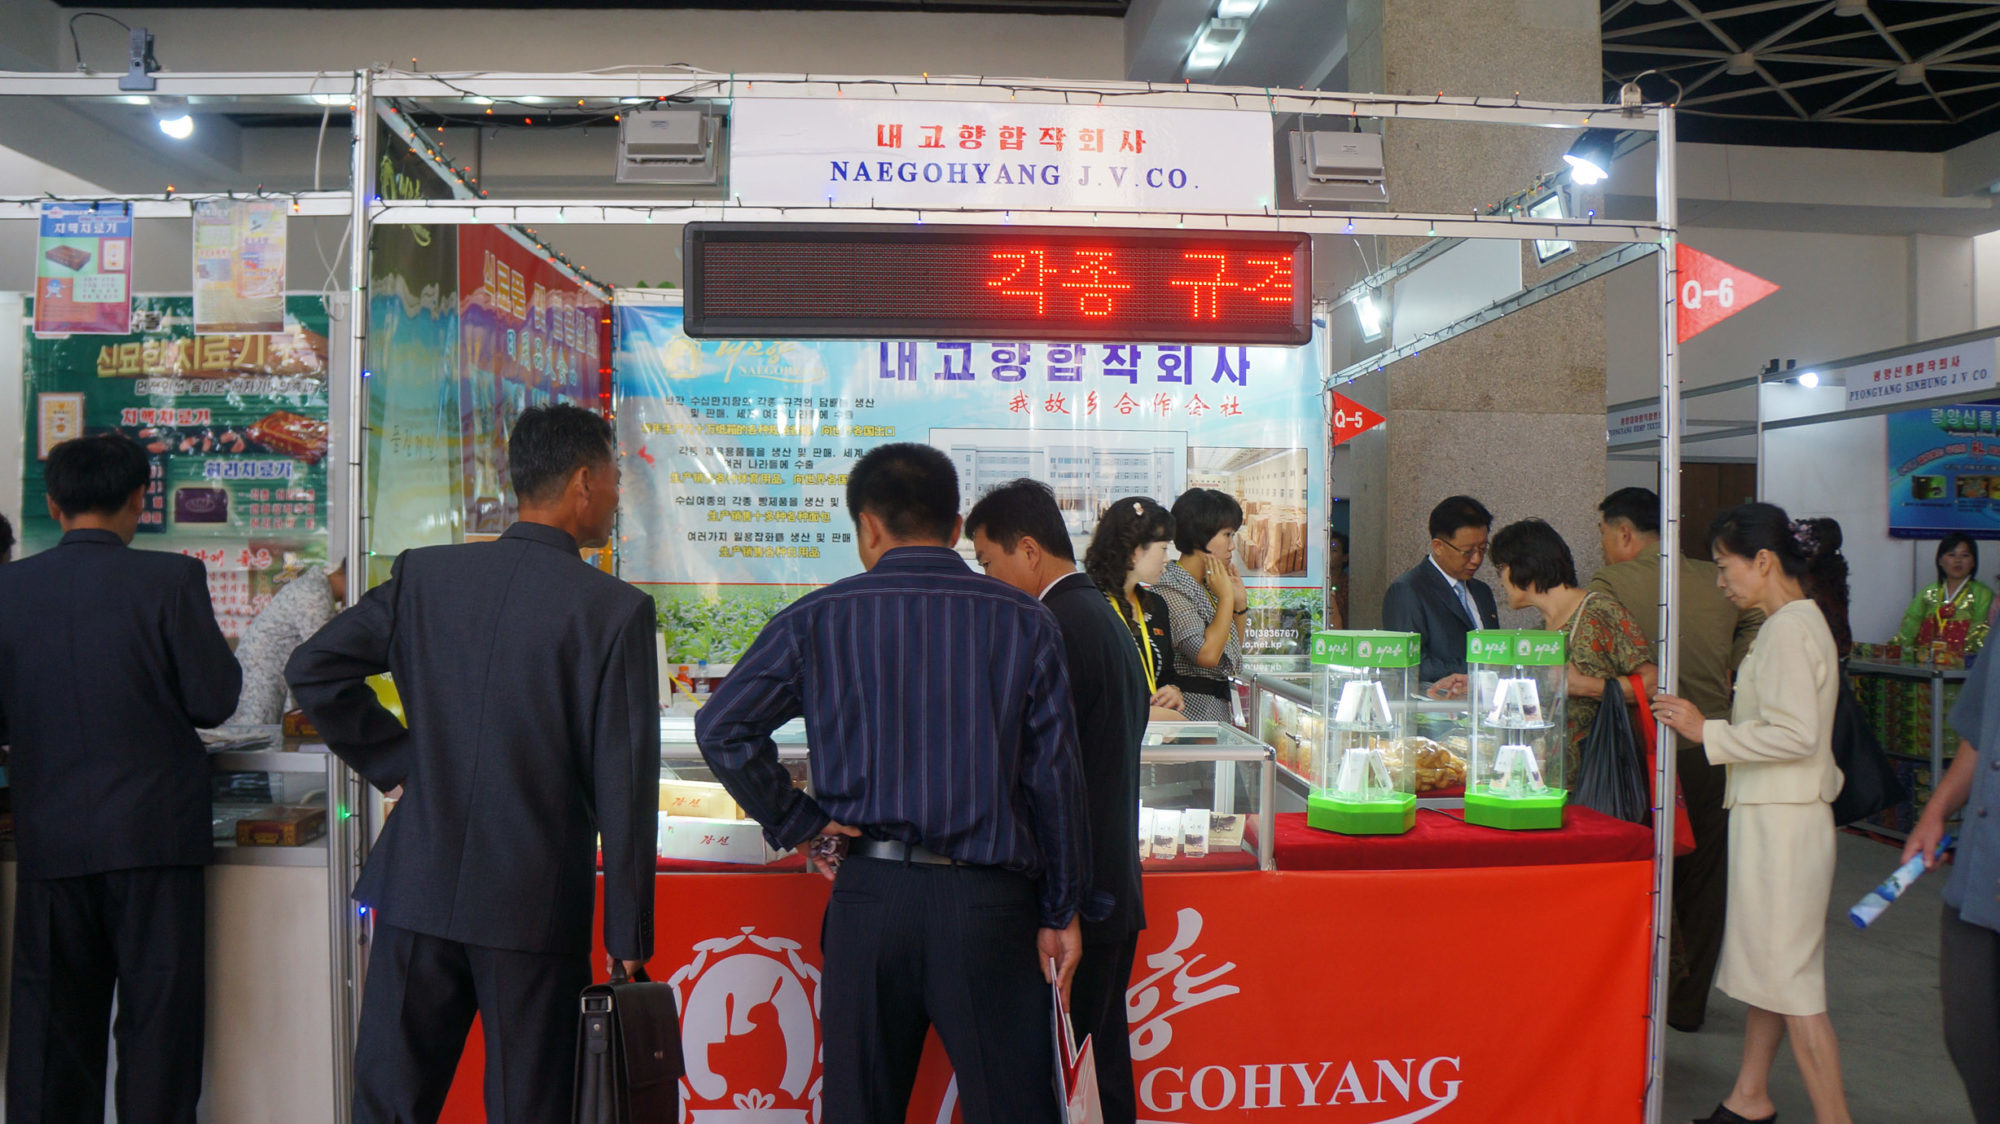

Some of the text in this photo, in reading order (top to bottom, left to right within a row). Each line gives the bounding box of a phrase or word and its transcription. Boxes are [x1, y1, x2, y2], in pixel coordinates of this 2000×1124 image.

[876, 123, 1147, 154] 내고향합작회사
[829, 160, 1061, 186] NAEGOHYANG
[988, 250, 1131, 316] 각종
[1682, 278, 1734, 310] Q-6
[880, 342, 1250, 386] 내고향합작회사
[1849, 384, 1901, 401] PYONGYANG
[855, 398, 875, 409] 생산
[1334, 409, 1364, 429] Q-5
[772, 447, 791, 457] 생산
[797, 447, 806, 457] 및
[748, 460, 789, 469] 나라들에
[795, 460, 814, 469] 수출
[732, 496, 752, 506] 각종
[804, 496, 824, 507] 생산
[830, 497, 839, 507] 및
[687, 531, 728, 542] 여러가지
[790, 532, 810, 543] 생산
[816, 533, 825, 543] 및
[831, 533, 851, 544] 판매
[1140, 1056, 1463, 1112] GOHYANG
